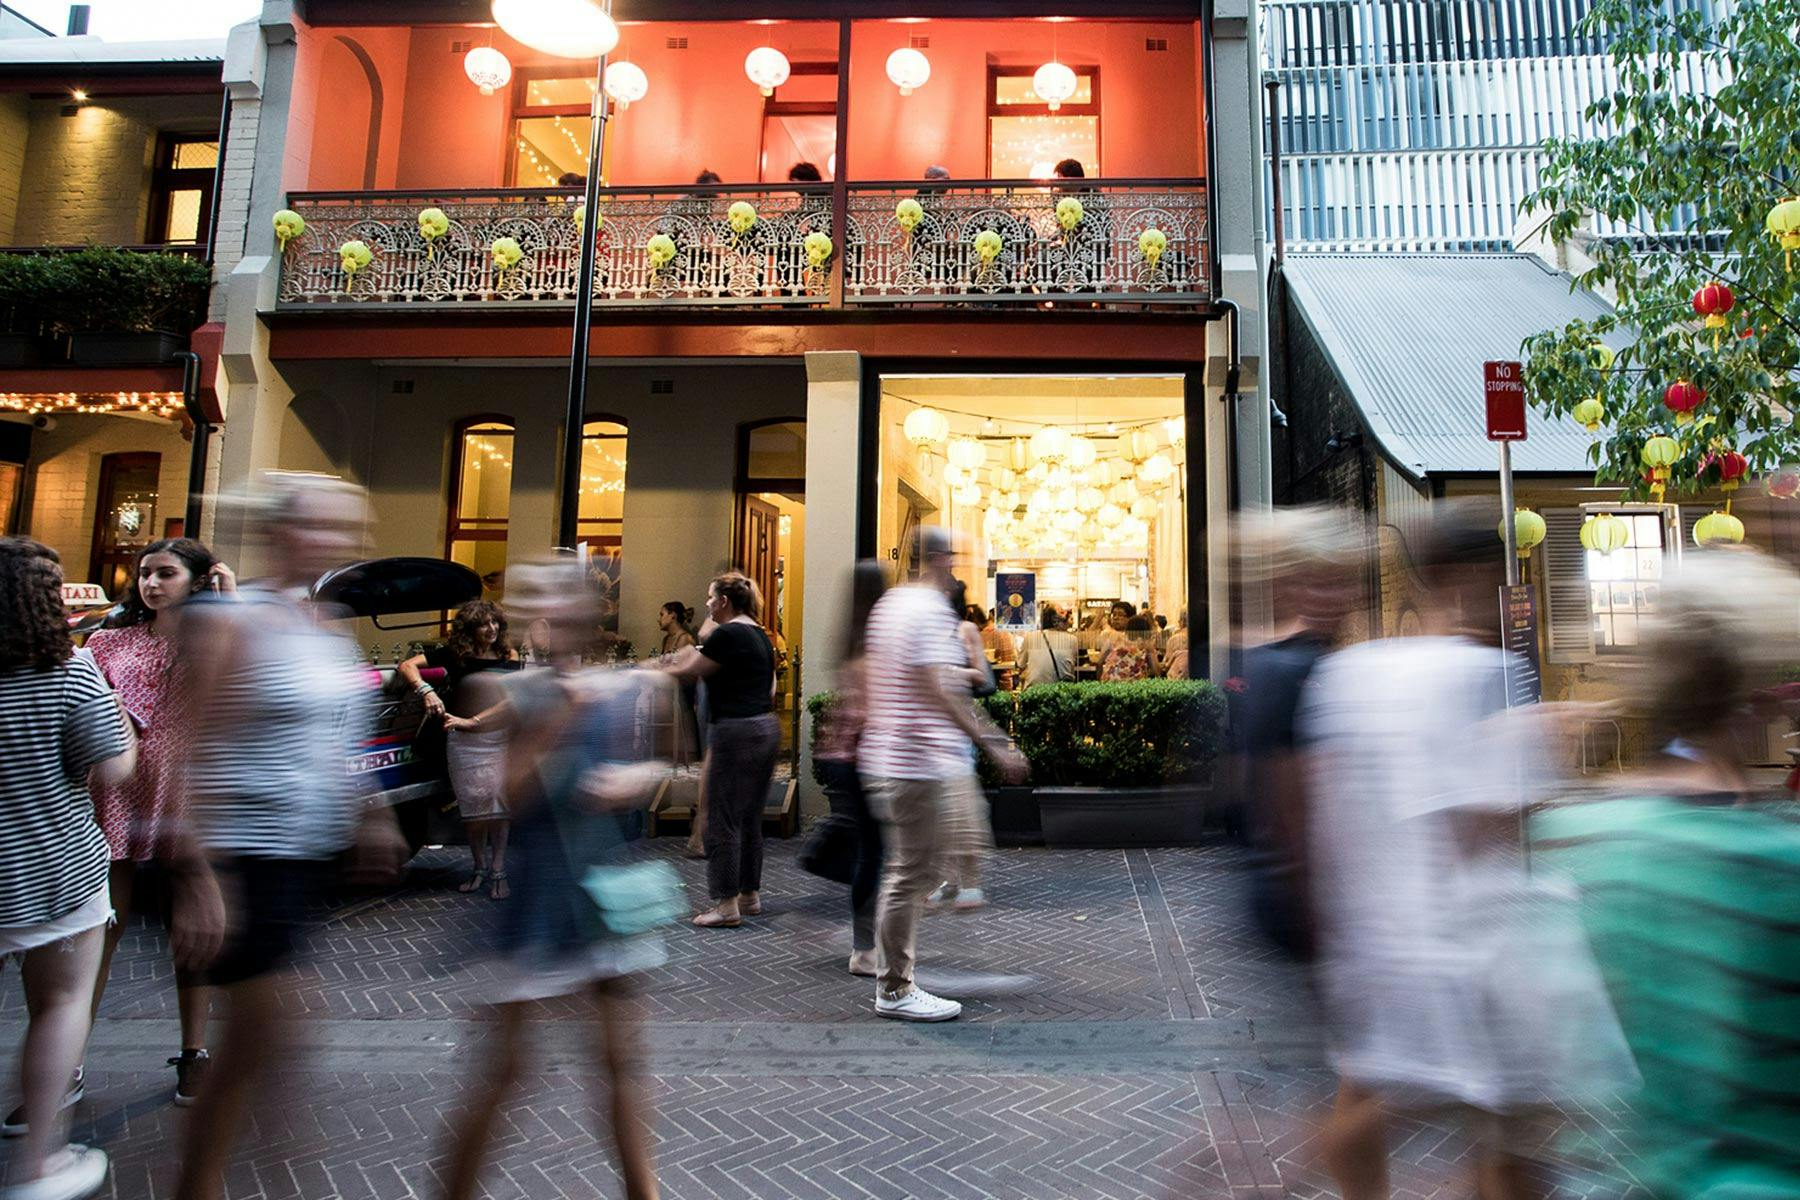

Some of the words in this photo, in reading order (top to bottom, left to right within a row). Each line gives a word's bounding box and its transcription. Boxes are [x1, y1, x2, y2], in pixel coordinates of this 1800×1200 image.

[1496, 366, 1511, 378] NO
[1487, 381, 1523, 392] STOPPING
[888, 547, 898, 560] 18
[63, 586, 98, 599] TAXI
